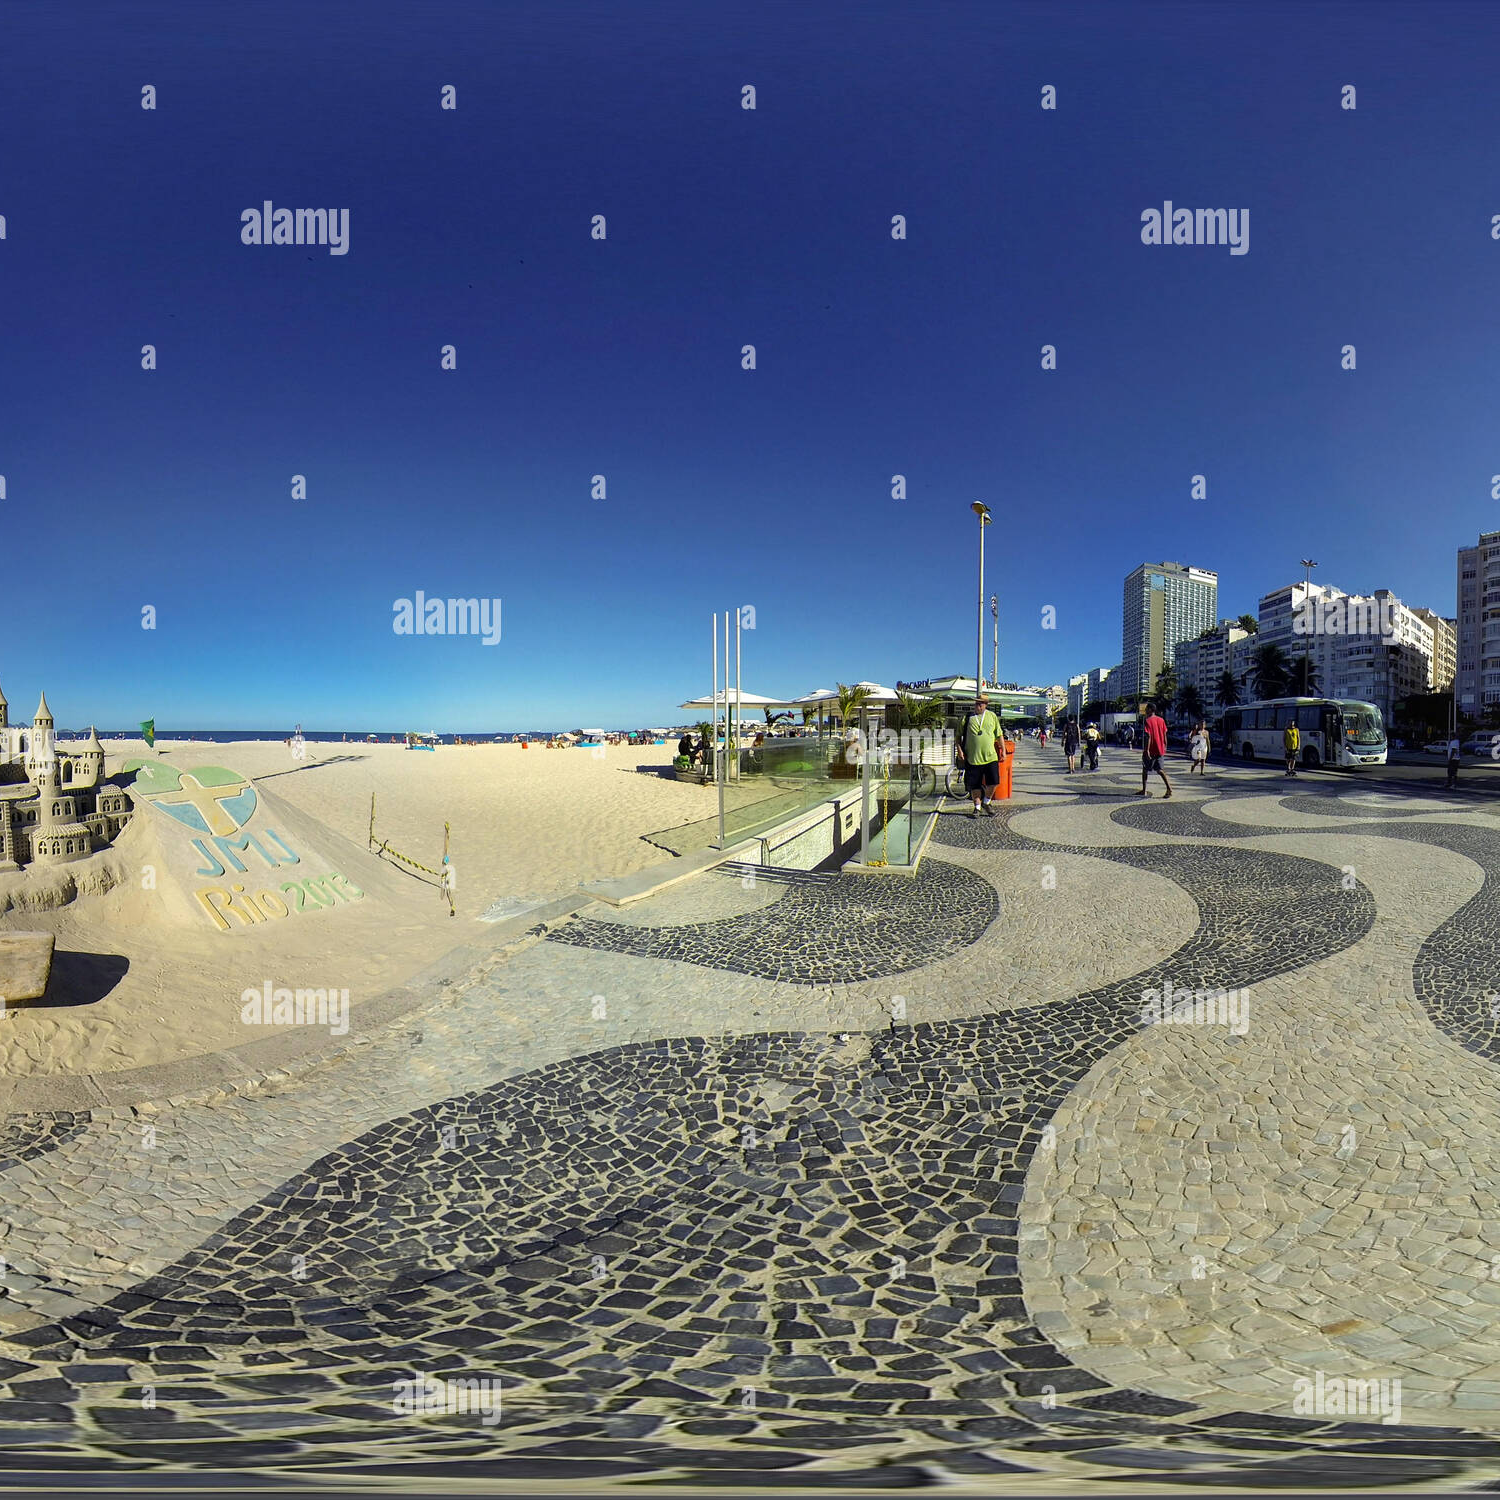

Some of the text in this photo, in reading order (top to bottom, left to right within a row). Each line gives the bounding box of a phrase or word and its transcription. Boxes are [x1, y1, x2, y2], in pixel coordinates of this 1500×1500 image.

[191, 828, 300, 878] JMJ
[195, 871, 365, 931] Rio 2013
